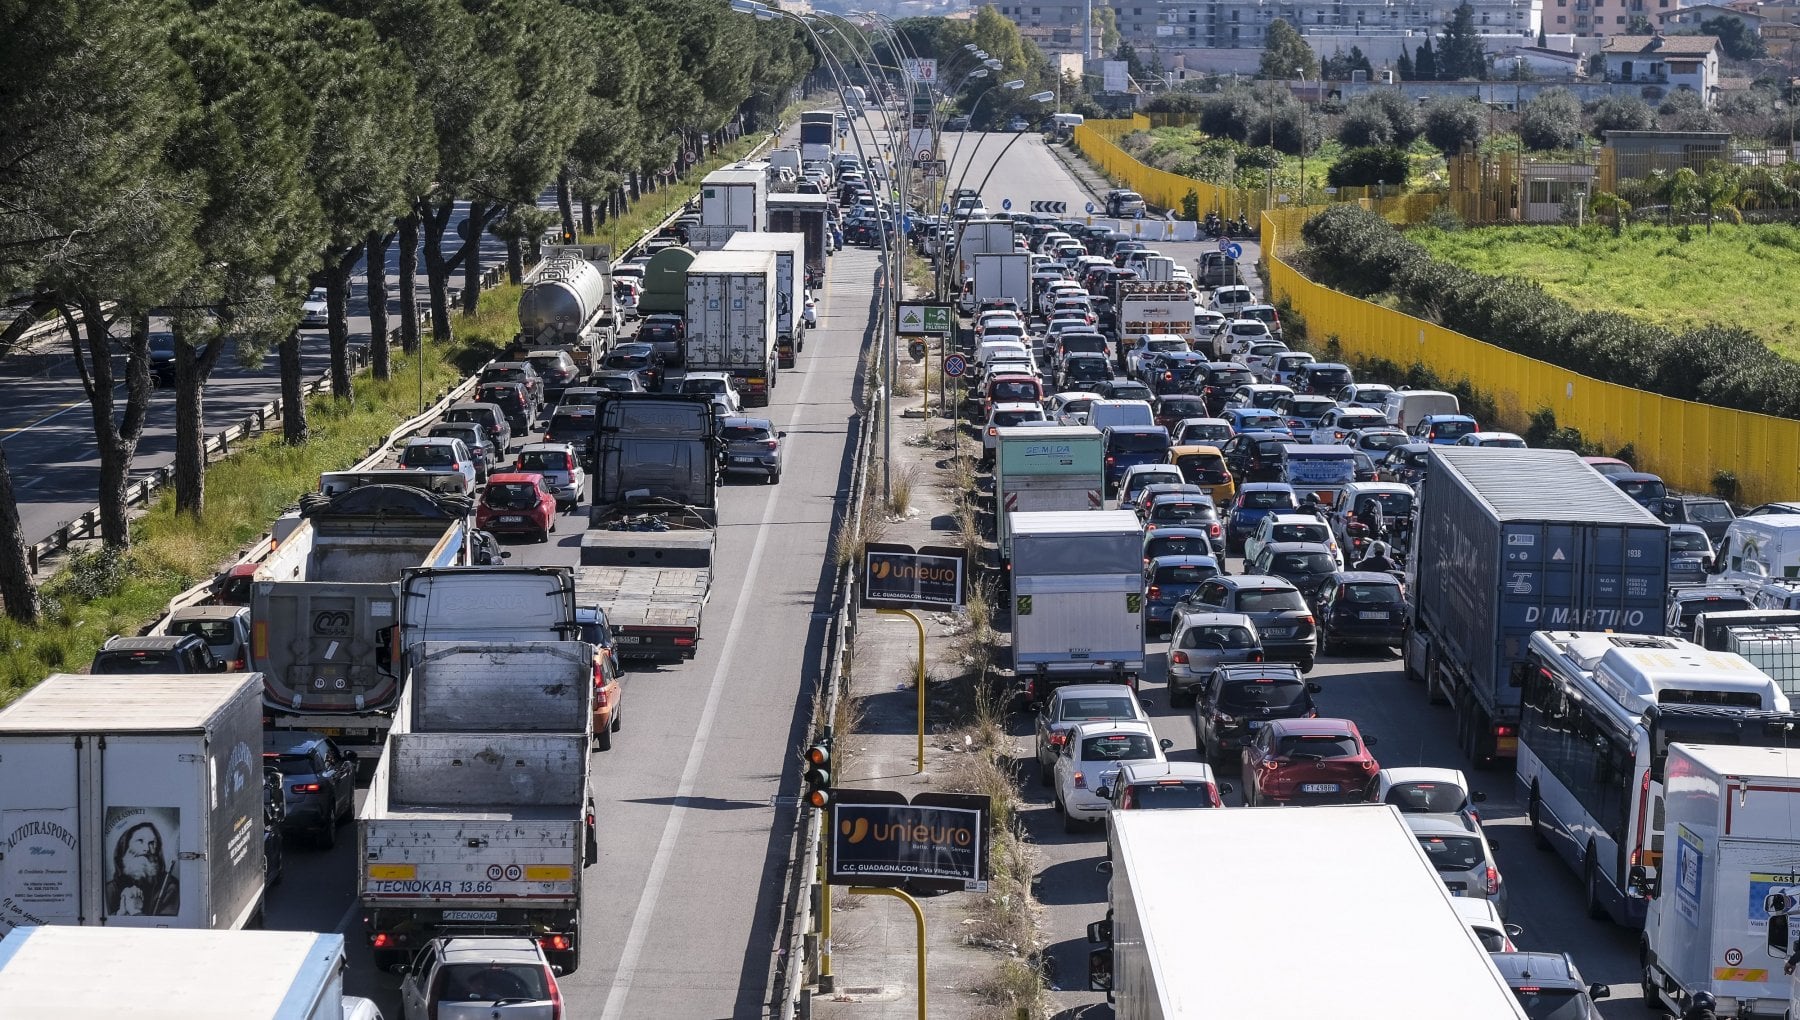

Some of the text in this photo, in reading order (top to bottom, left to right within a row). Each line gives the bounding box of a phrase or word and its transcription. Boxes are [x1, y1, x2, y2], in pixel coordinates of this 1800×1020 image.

[893, 563, 955, 581] unieuro
[1551, 607, 1644, 627] MARTINO
[7, 820, 77, 853] AUTOTRASPORTI
[873, 818, 971, 846] unieuro
[858, 864, 918, 873] GUADAGNA.COM
[375, 881, 493, 893] TECNOKAR 13.66
[451, 911, 497, 920] TECNOKAR
[1728, 952, 1740, 961] 100
